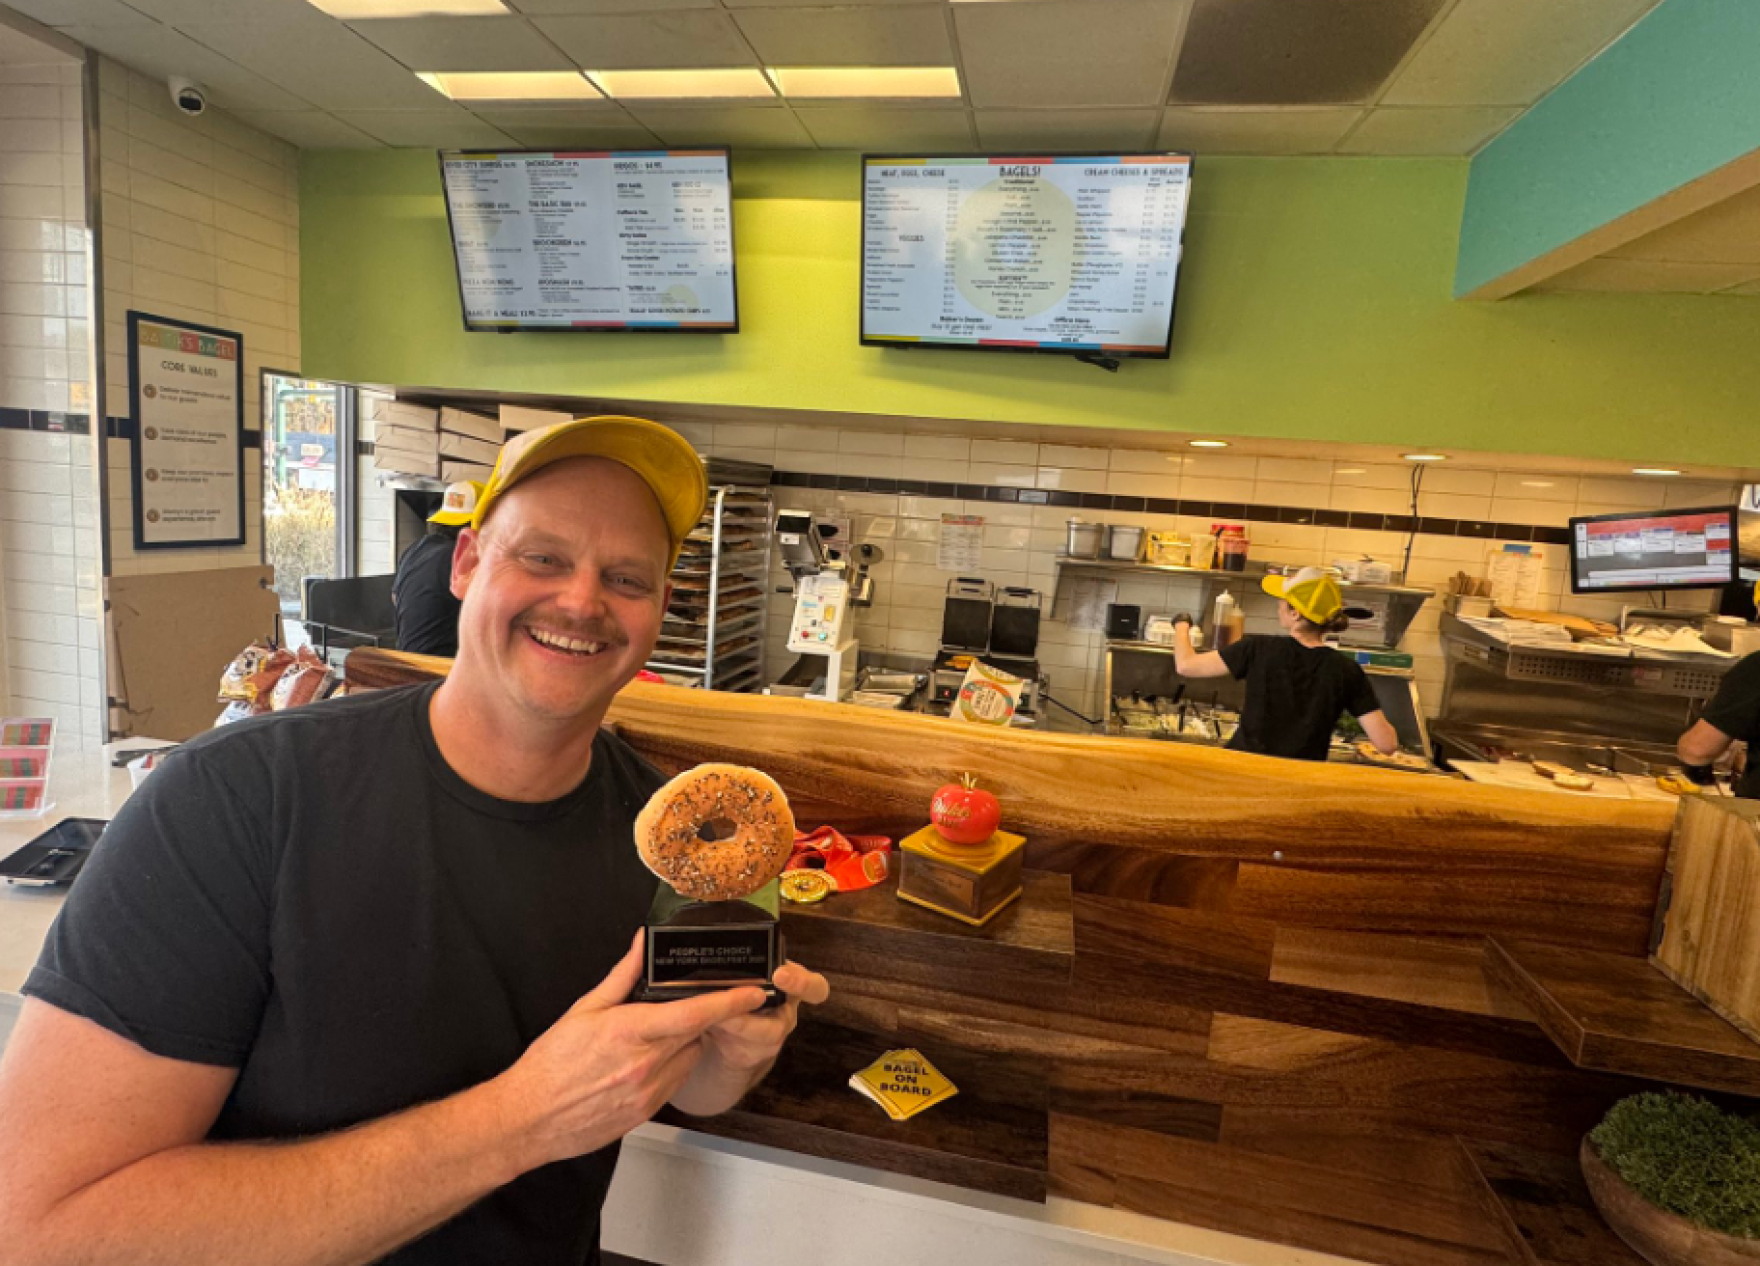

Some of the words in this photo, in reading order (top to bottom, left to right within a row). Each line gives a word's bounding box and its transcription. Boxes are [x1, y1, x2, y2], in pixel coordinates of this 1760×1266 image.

[999, 165, 1041, 177] BAGELS!
[160, 360, 185, 373] CORE
[187, 365, 218, 378] VALUES
[669, 946, 715, 957] PEOPLE'S
[715, 945, 753, 956] CHOICE
[655, 957, 675, 965] NEW
[675, 957, 699, 965] YORK
[883, 1064, 929, 1076] BAGEL
[894, 1074, 918, 1084] ON
[880, 1082, 932, 1097] BOARD
